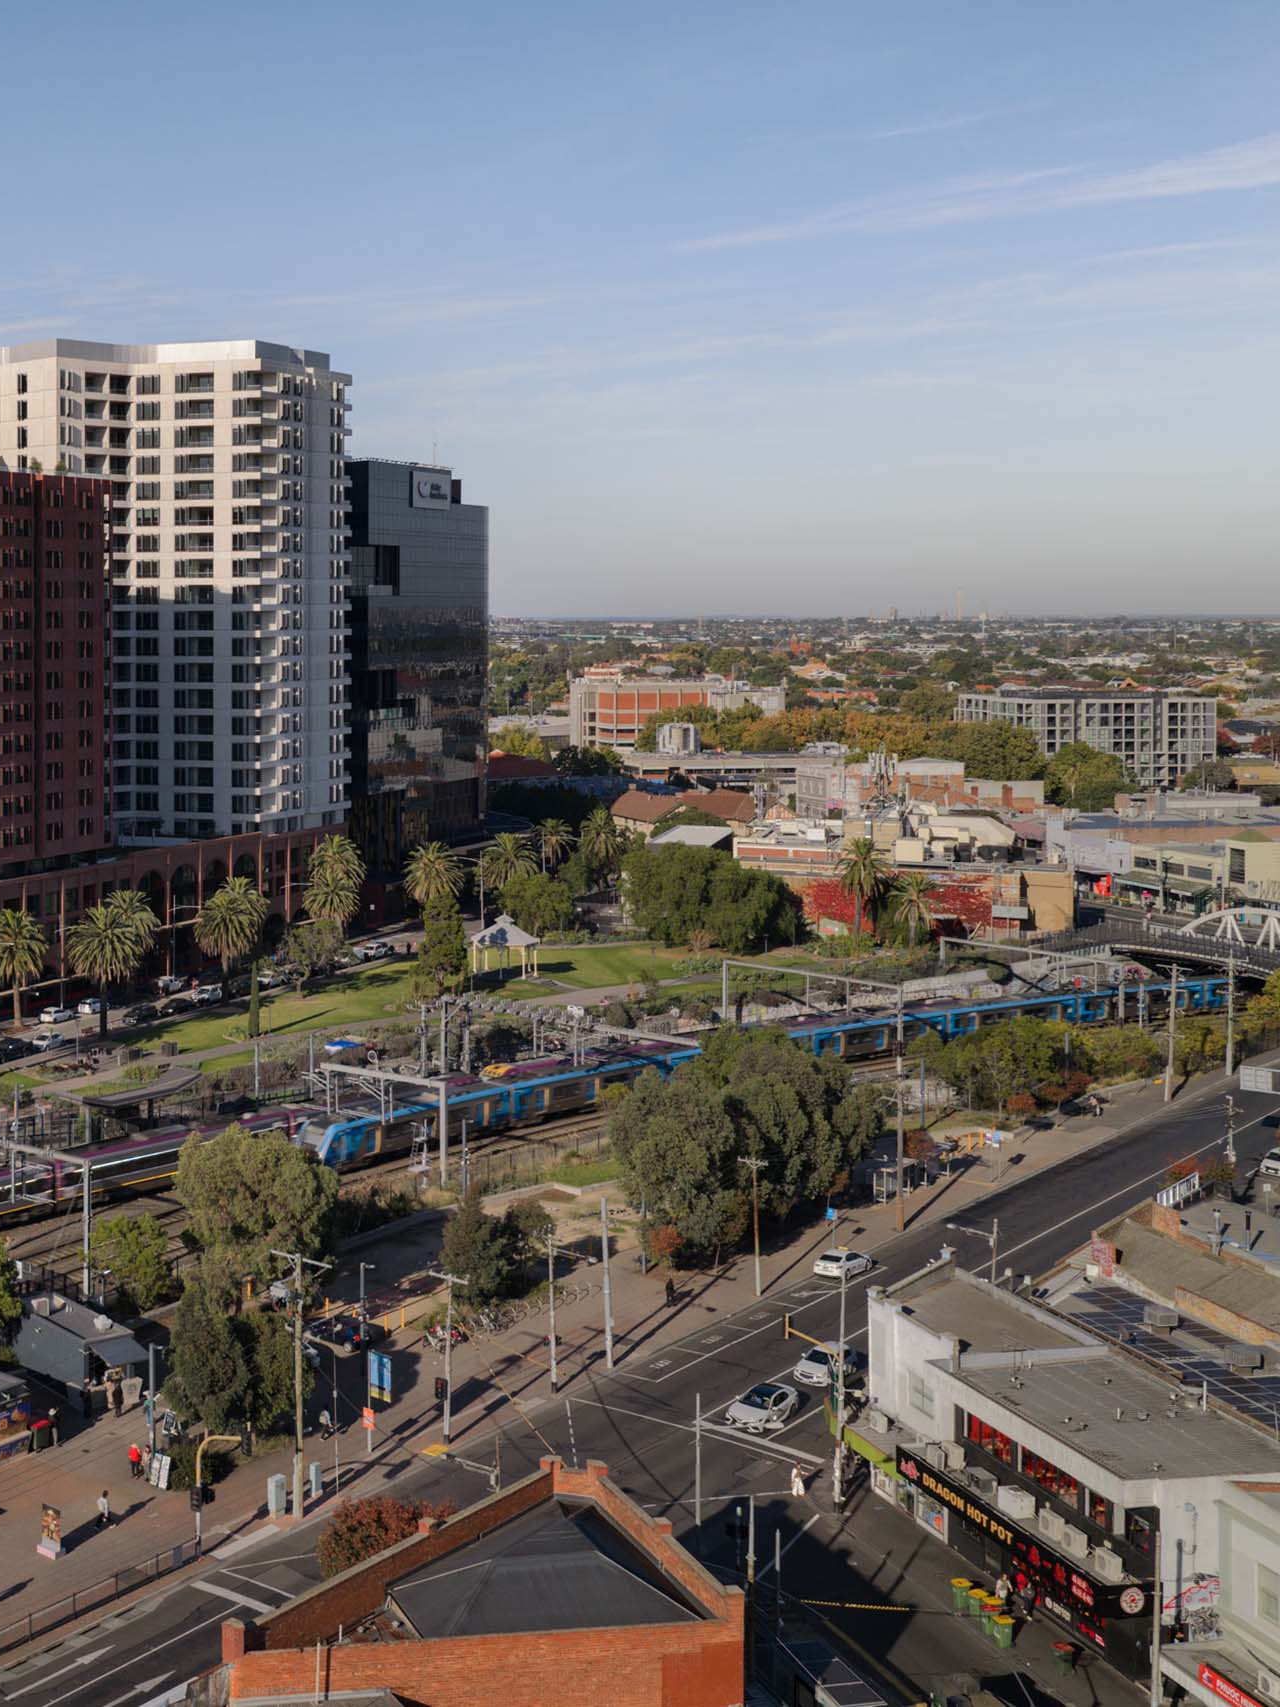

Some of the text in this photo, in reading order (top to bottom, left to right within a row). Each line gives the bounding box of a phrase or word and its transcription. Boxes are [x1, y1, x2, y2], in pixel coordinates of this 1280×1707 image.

[922, 1473, 1014, 1545] DRAGON HOT POT
